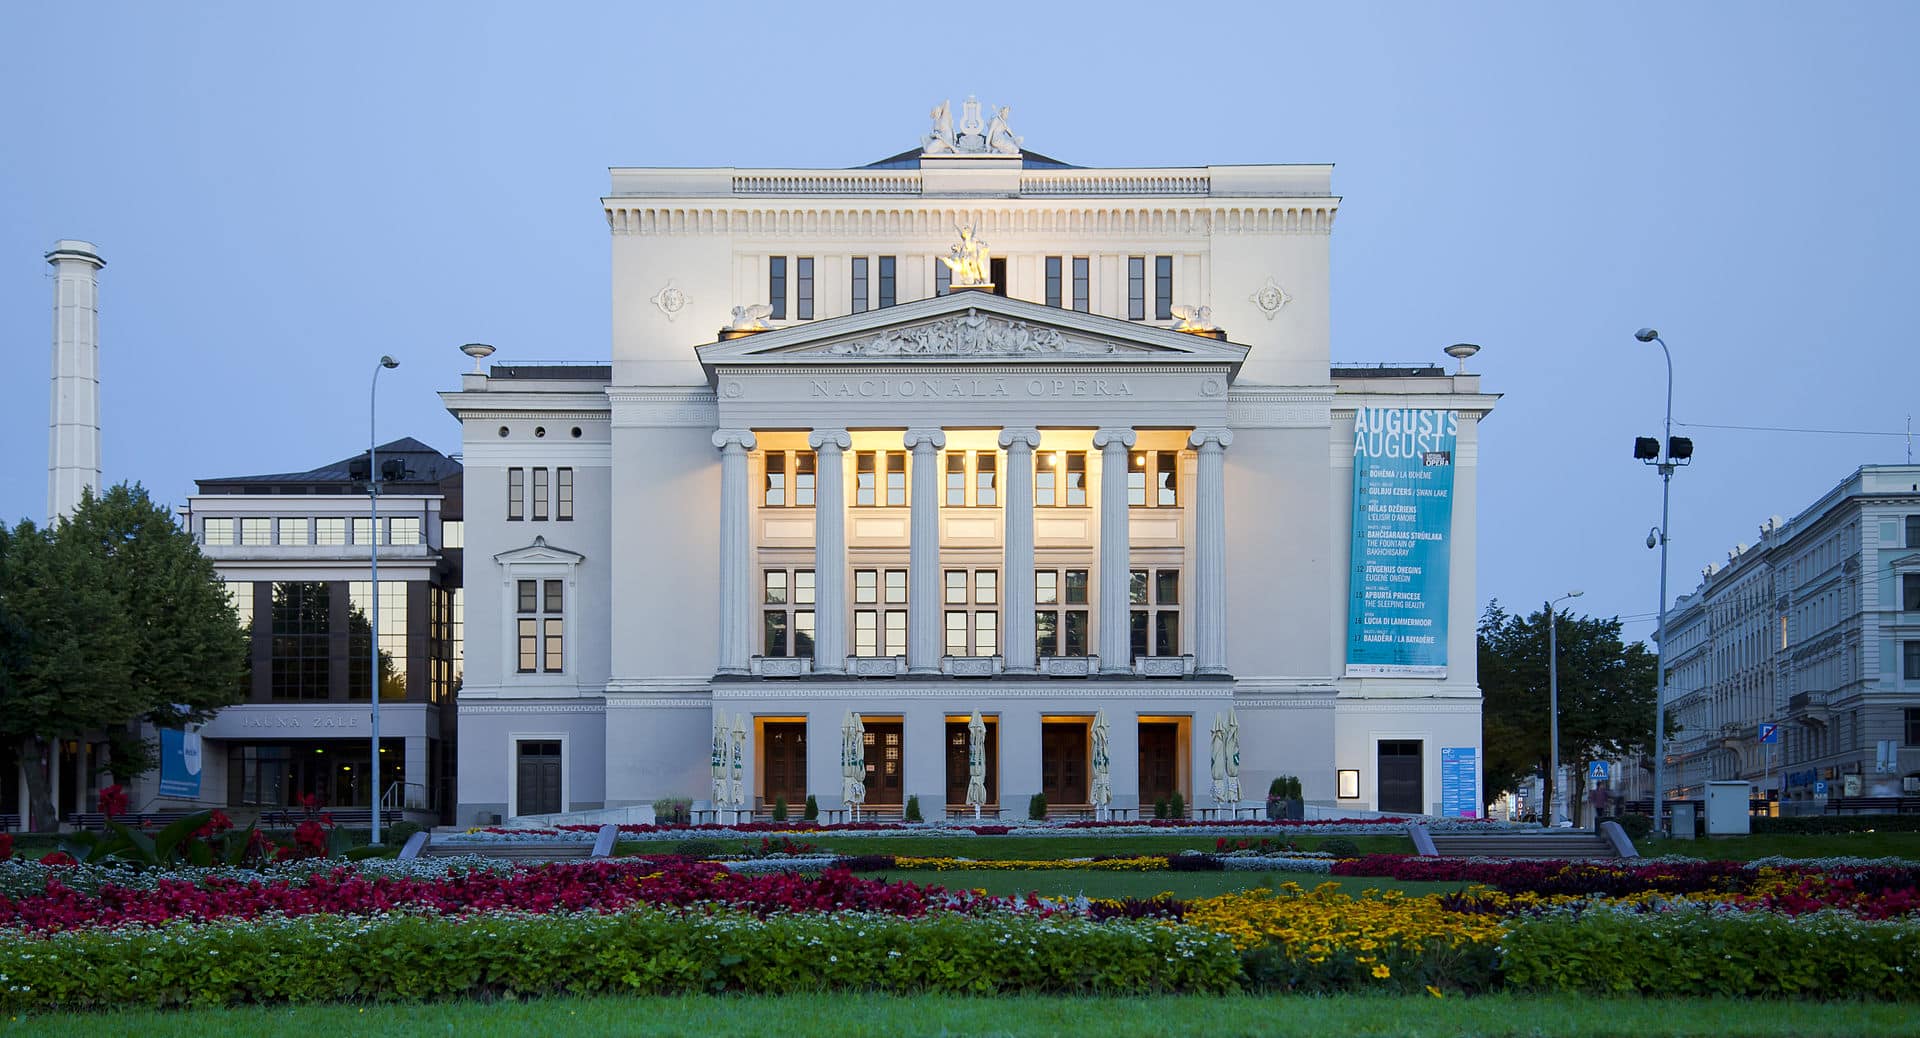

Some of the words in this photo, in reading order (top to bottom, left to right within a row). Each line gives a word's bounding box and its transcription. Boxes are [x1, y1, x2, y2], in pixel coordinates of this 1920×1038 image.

[810, 378, 1009, 397] NACIONĀLĀ
[1027, 379, 1133, 397] OPERA
[1354, 407, 1458, 436] AUGUSTS
[1353, 432, 1445, 458] AUGUST
[1433, 490, 1448, 498] LAKE
[1367, 540, 1378, 548] THE
[1380, 540, 1408, 548] FOUNTAIN
[1365, 600, 1376, 608] THE
[1364, 616, 1382, 625] LUCIA
[1763, 726, 1774, 741] P
[1816, 783, 1824, 793] P
